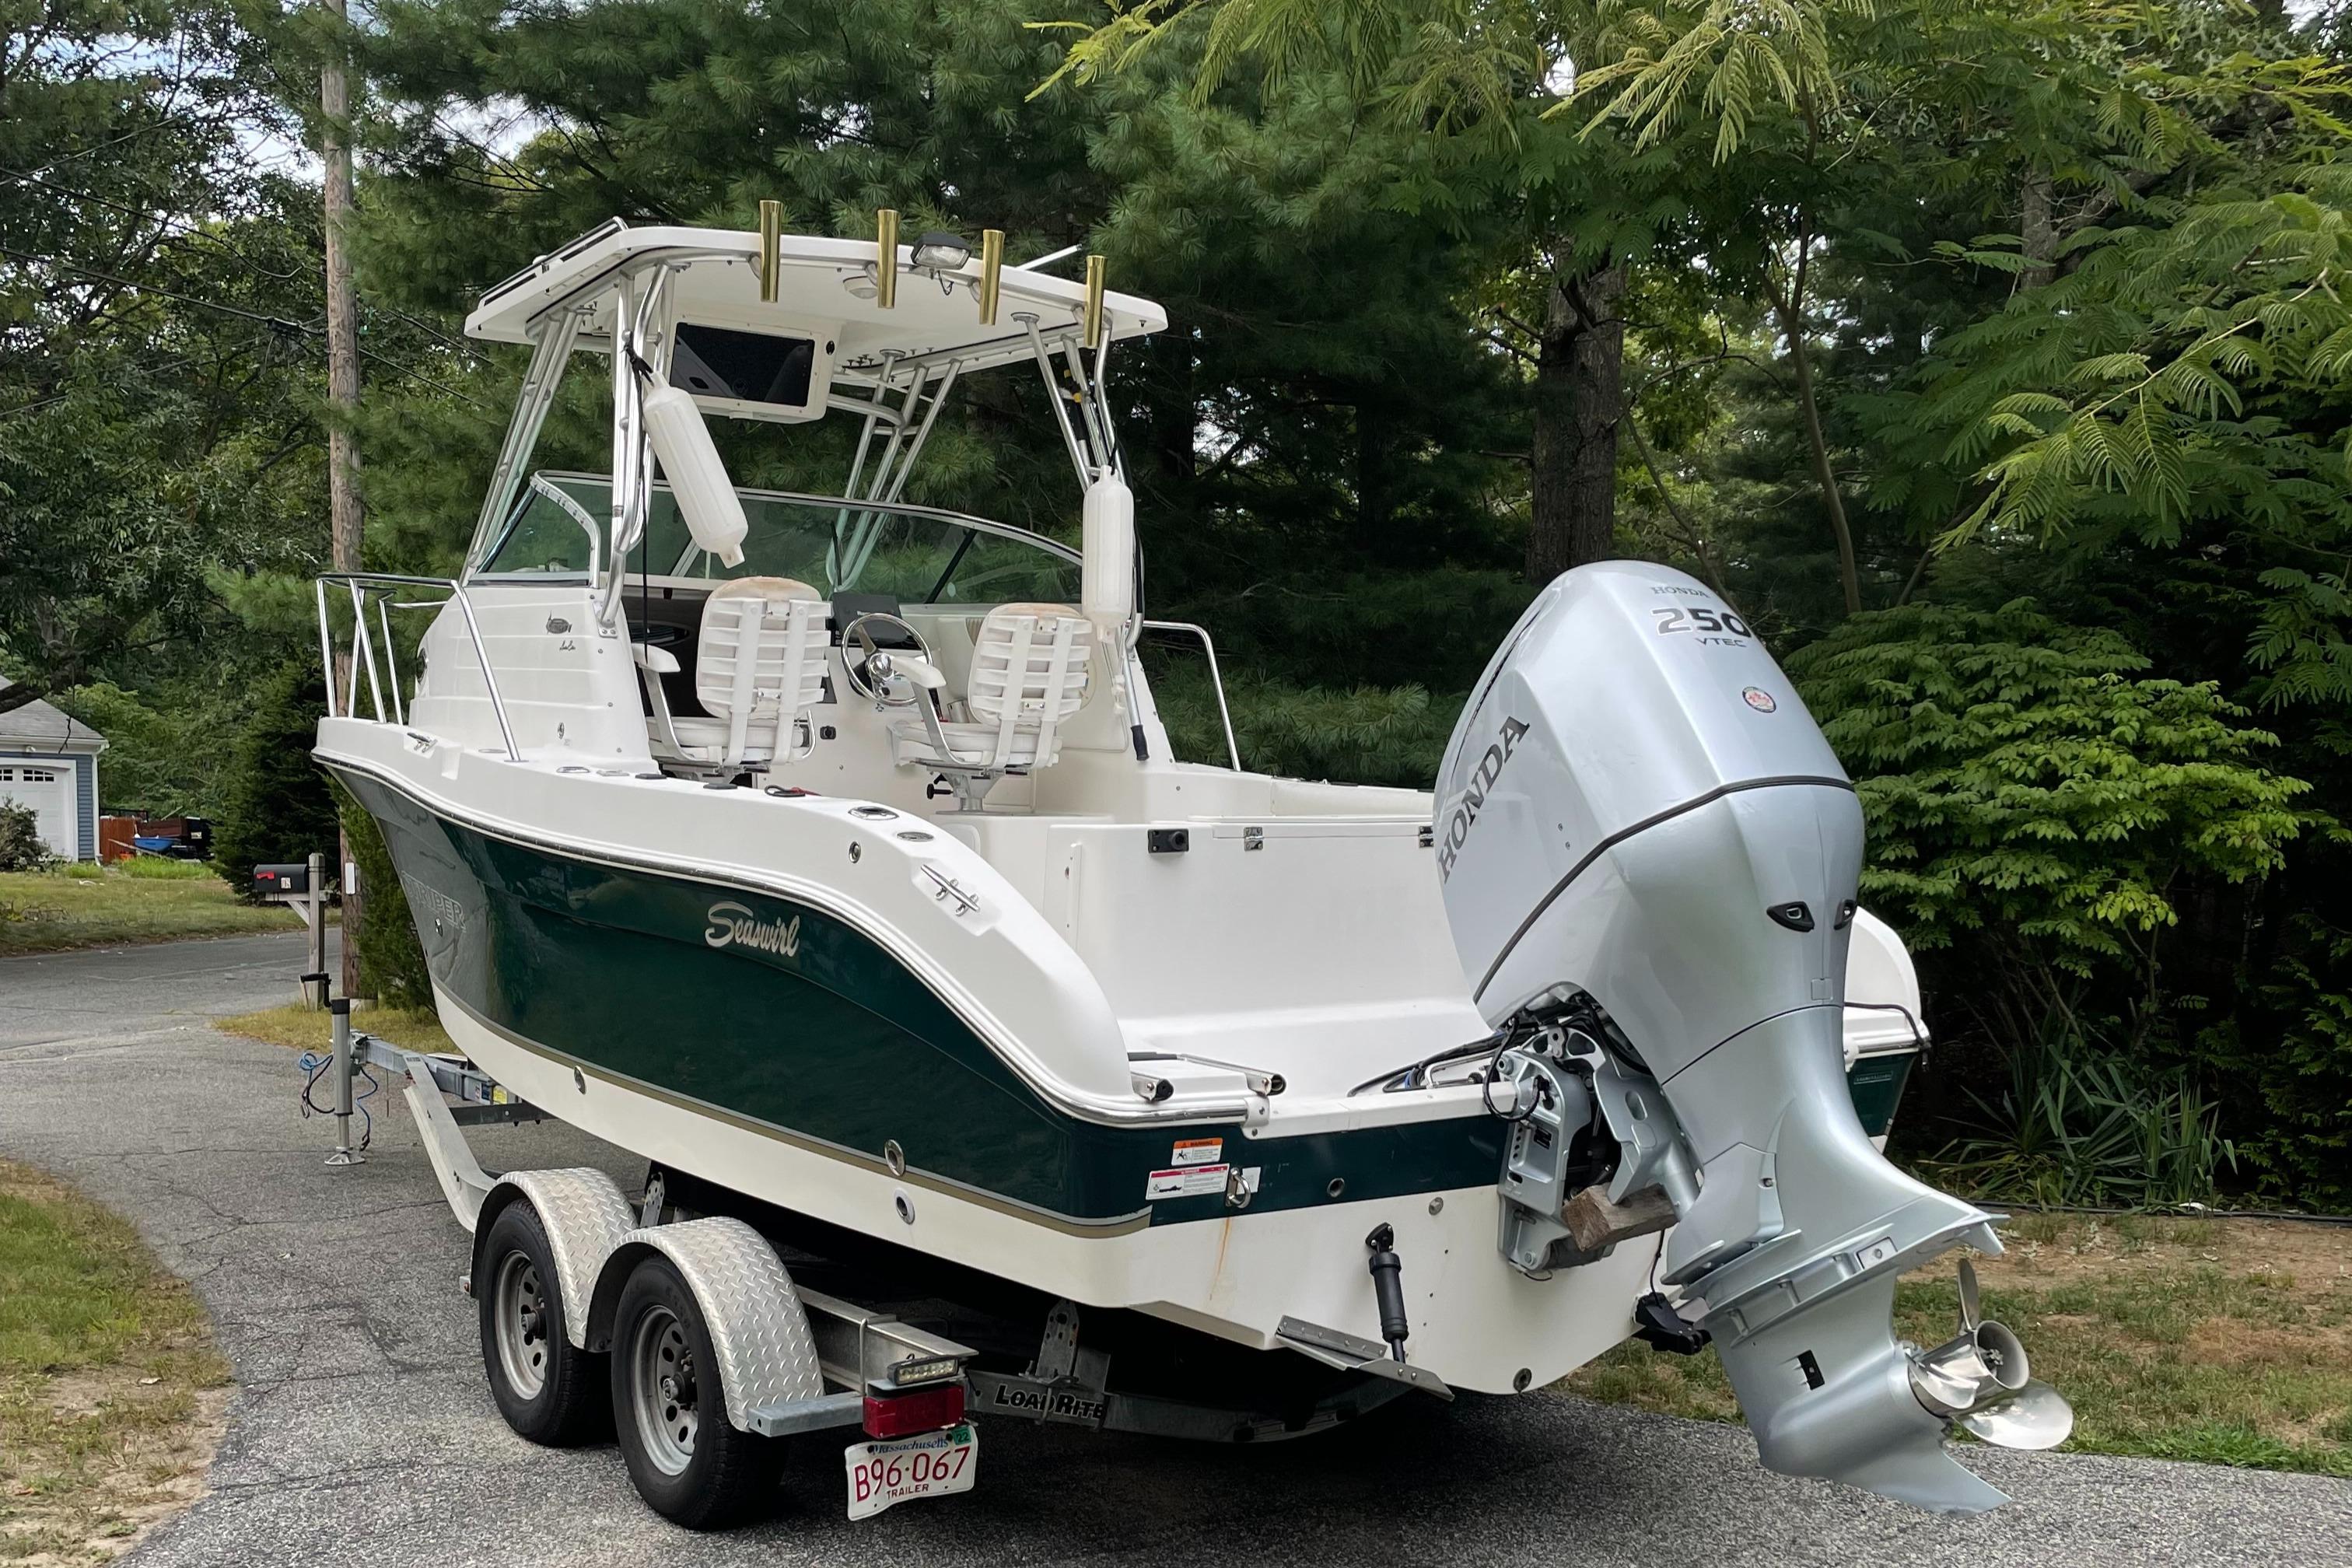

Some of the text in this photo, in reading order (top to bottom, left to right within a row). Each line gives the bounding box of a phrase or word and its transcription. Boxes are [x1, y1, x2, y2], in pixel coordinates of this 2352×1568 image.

[1651, 586, 1710, 598] HONDA
[1650, 607, 1752, 639] 250
[1694, 637, 1748, 648] VTEC
[1438, 716, 1531, 884] HONDA
[704, 900, 800, 957] Seaswirl
[872, 1436, 949, 1456] Massachusetts
[956, 1431, 970, 1443] 22
[887, 1483, 929, 1500] TRAILER
